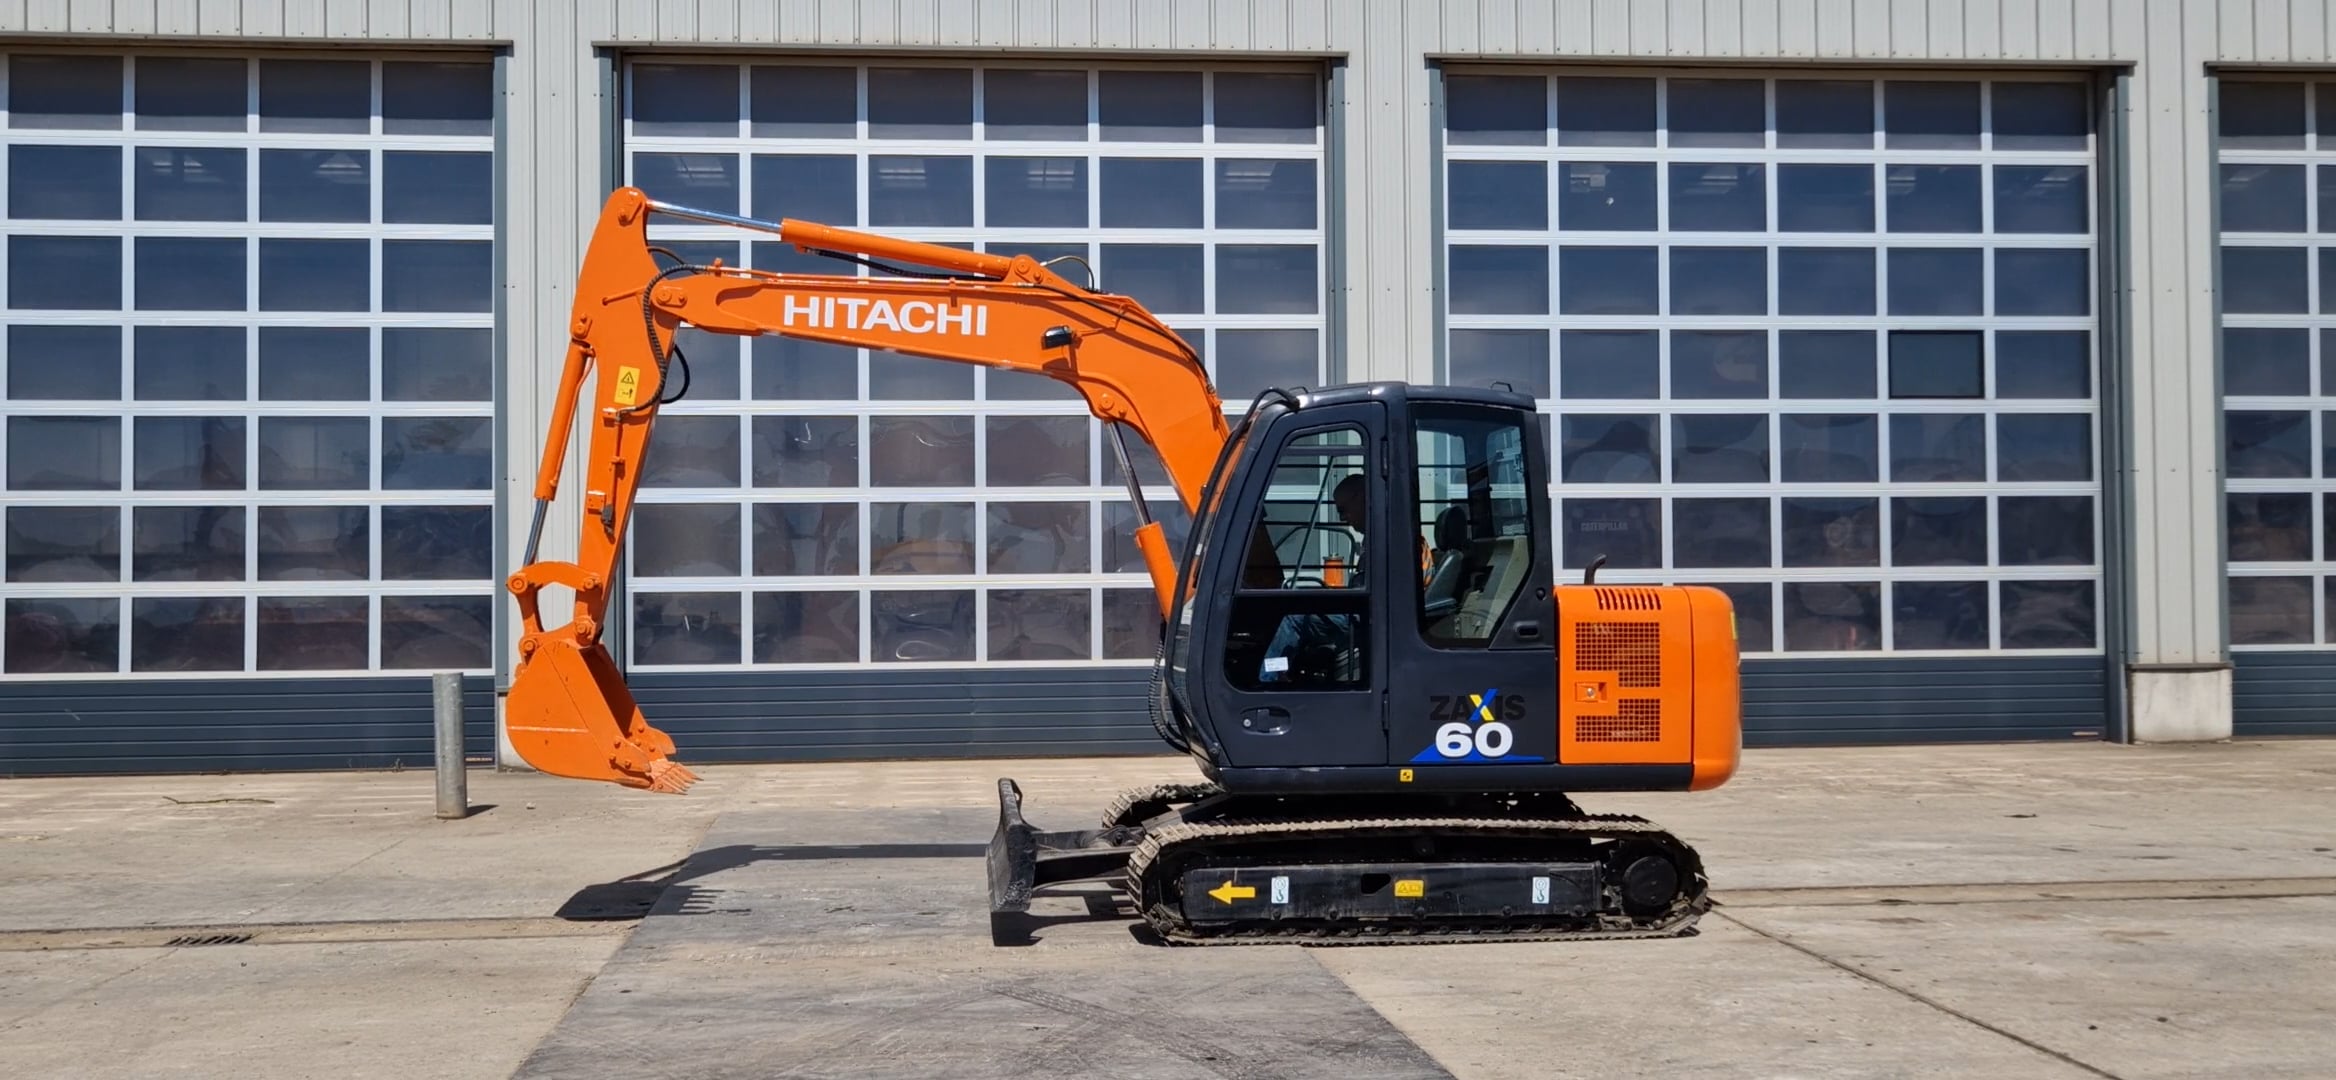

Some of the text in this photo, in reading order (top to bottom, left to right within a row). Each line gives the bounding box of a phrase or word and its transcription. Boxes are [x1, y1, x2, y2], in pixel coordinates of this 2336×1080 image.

[783, 294, 988, 337] HITACHI
[1429, 688, 1526, 721] ZAXIS
[1435, 721, 1514, 758] 60
